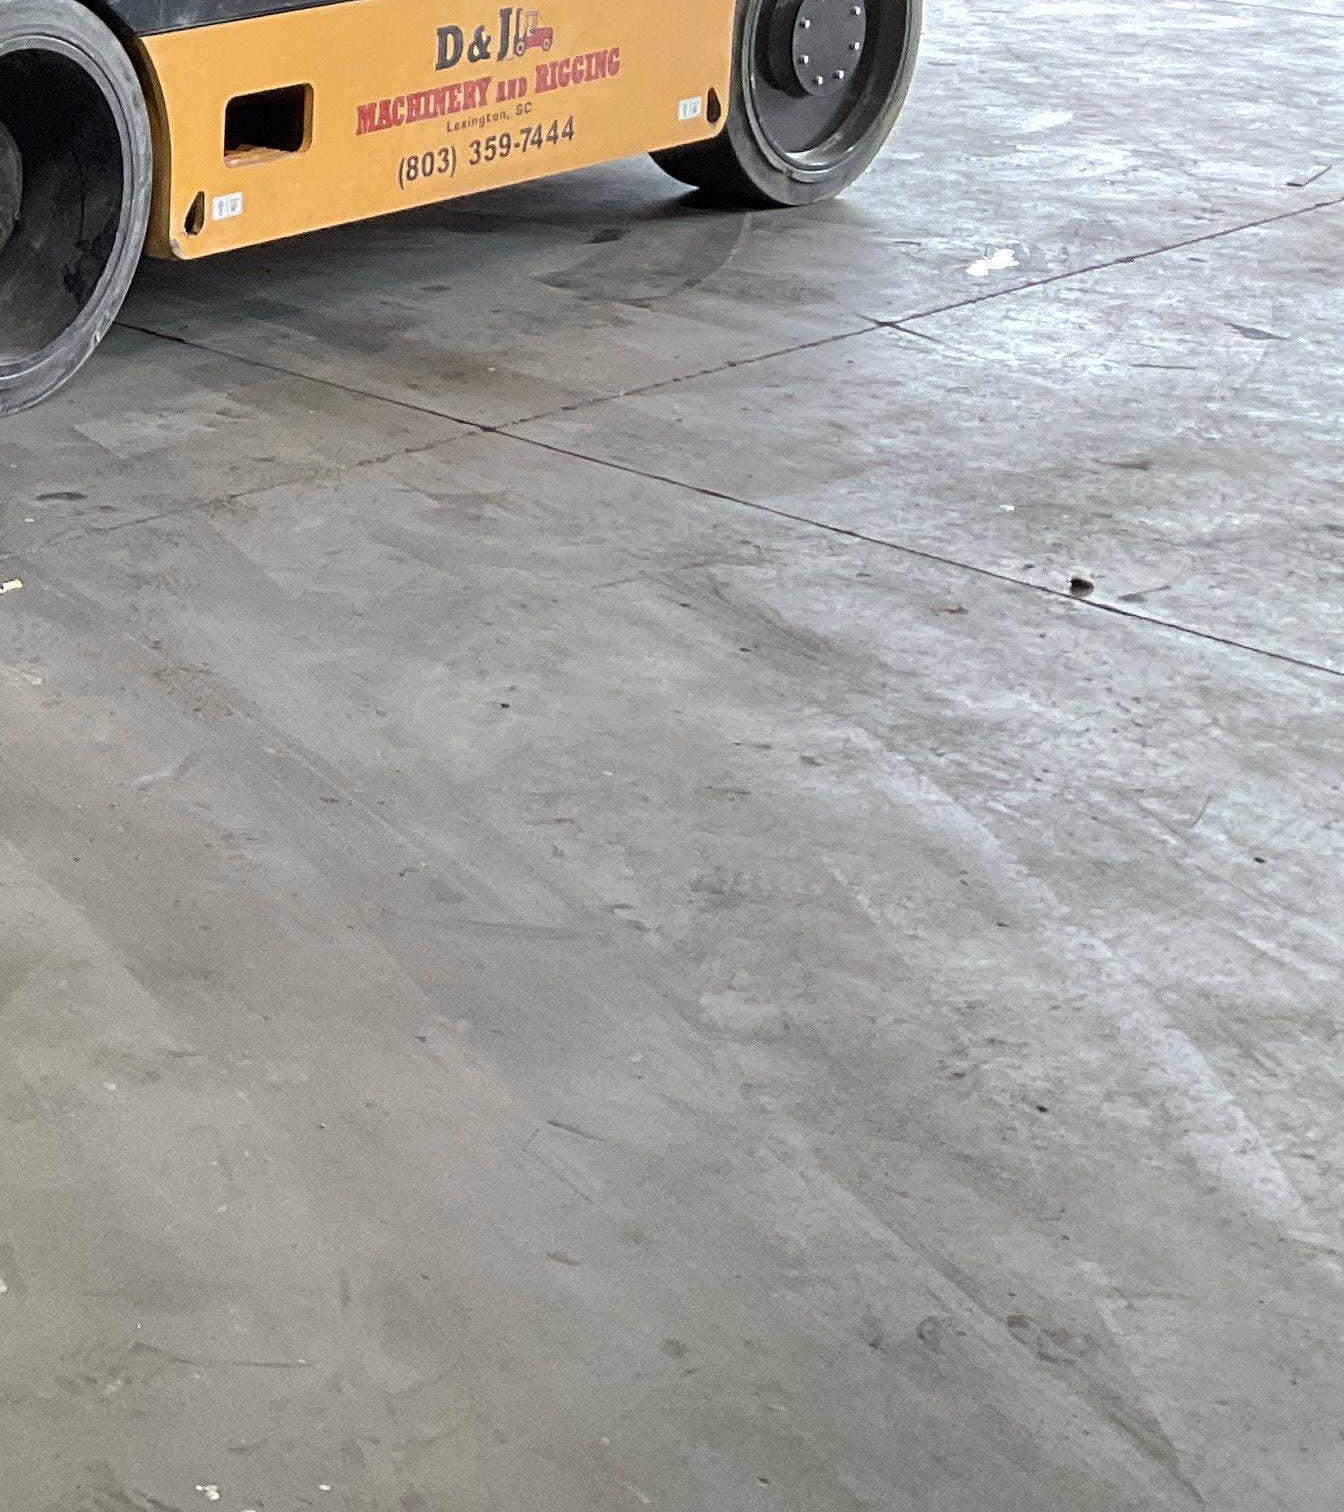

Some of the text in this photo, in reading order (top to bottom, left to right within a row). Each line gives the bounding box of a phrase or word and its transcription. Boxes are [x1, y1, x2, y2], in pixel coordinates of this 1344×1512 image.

[355, 47, 620, 136] MACHINERY AND RIGGING
[446, 101, 533, 133] Lexington, SC
[398, 115, 575, 190] (803) 359-7444
